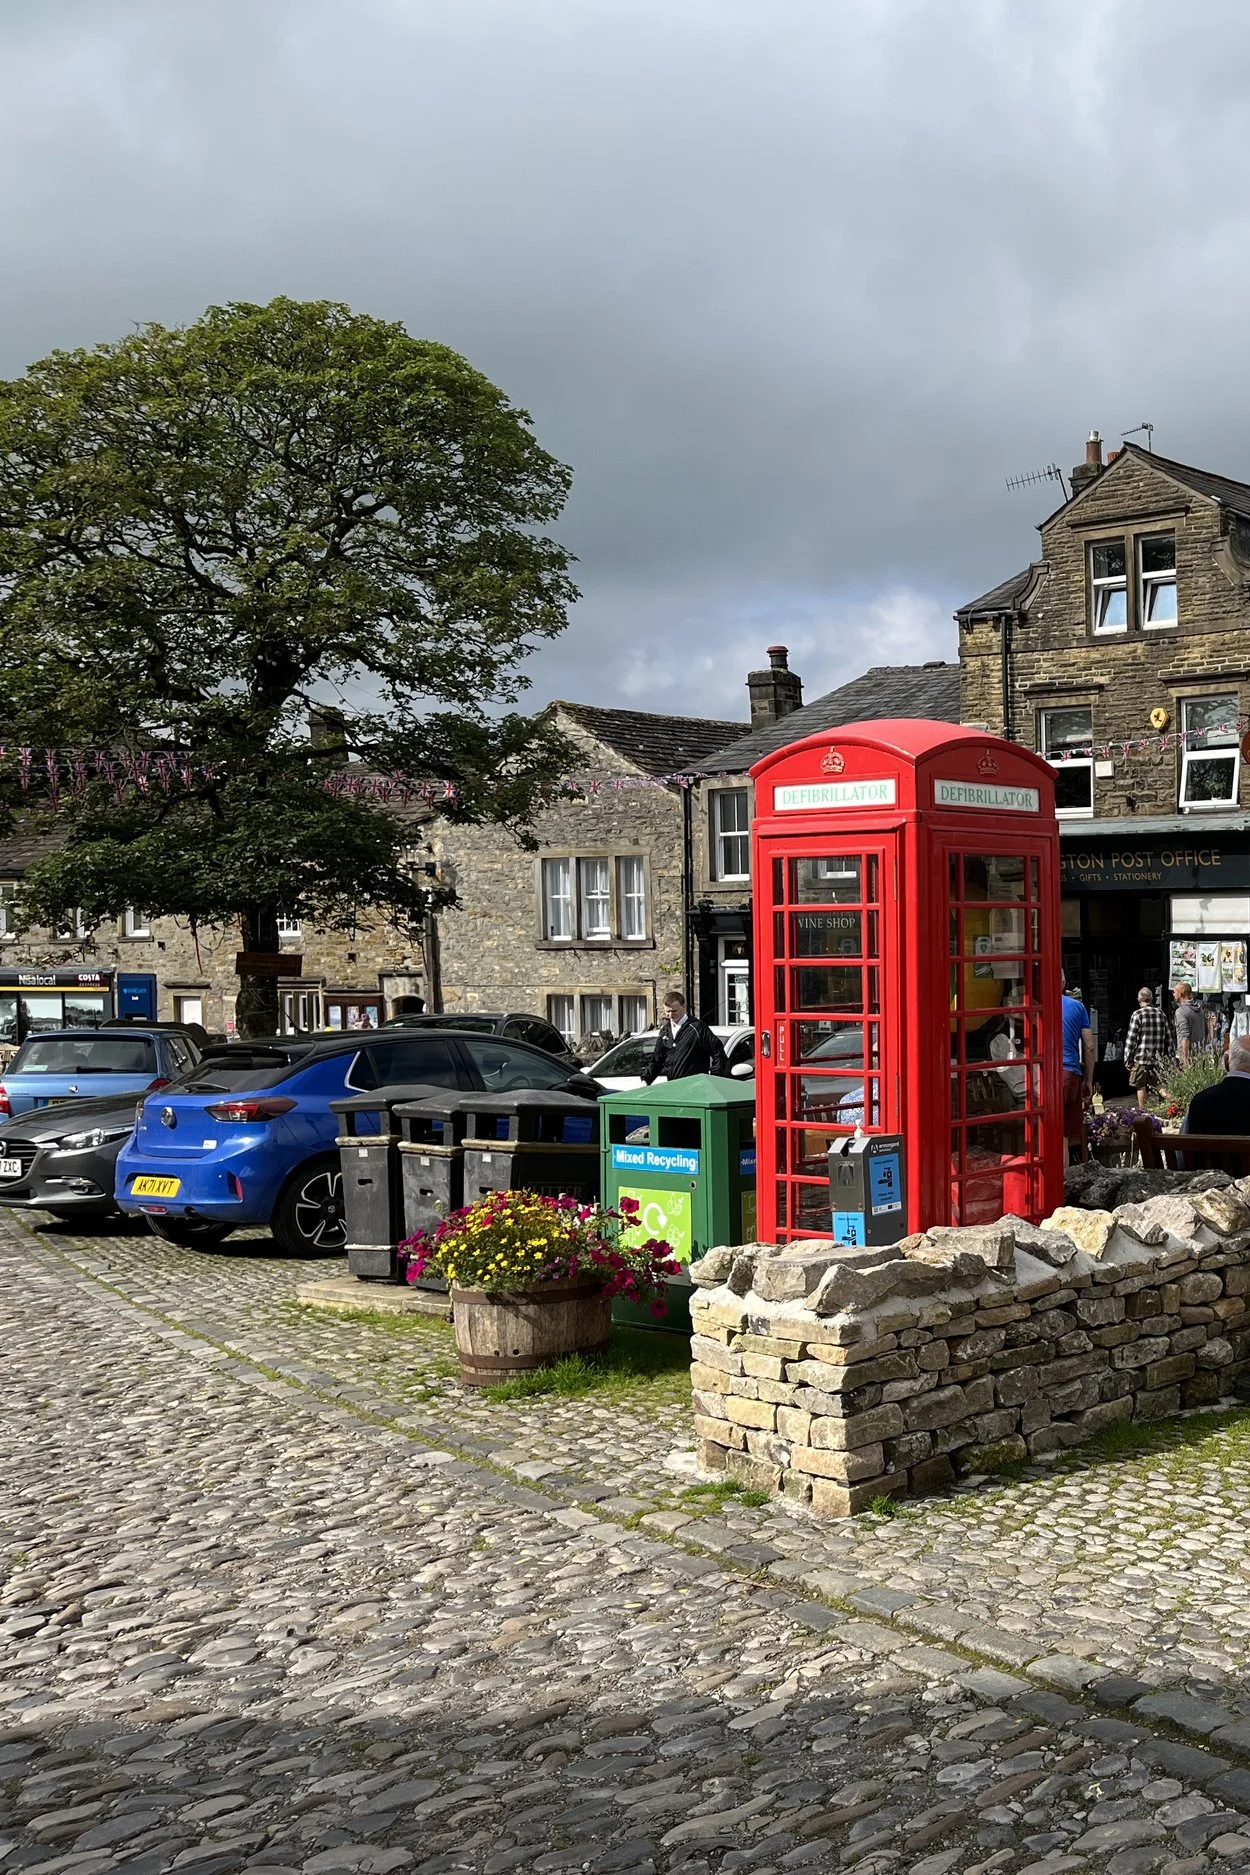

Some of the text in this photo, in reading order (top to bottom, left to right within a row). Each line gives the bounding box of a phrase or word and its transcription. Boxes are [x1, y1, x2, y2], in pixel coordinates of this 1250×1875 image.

[782, 784, 888, 805] DEFIBRILLATOR
[941, 786, 1032, 808] DEFIBRILLATOR
[1112, 851, 1154, 868] POST
[1160, 849, 1222, 867] OFFICE
[1079, 873, 1102, 882] GIFTS
[1113, 872, 1162, 881] STATIONERY
[826, 917, 856, 928] SHOP
[78, 974, 100, 982] COSTA
[3, 1160, 17, 1173] ZXC
[616, 1150, 697, 1172] Mixed Recycling
[137, 1179, 175, 1194] AK71 XVT
